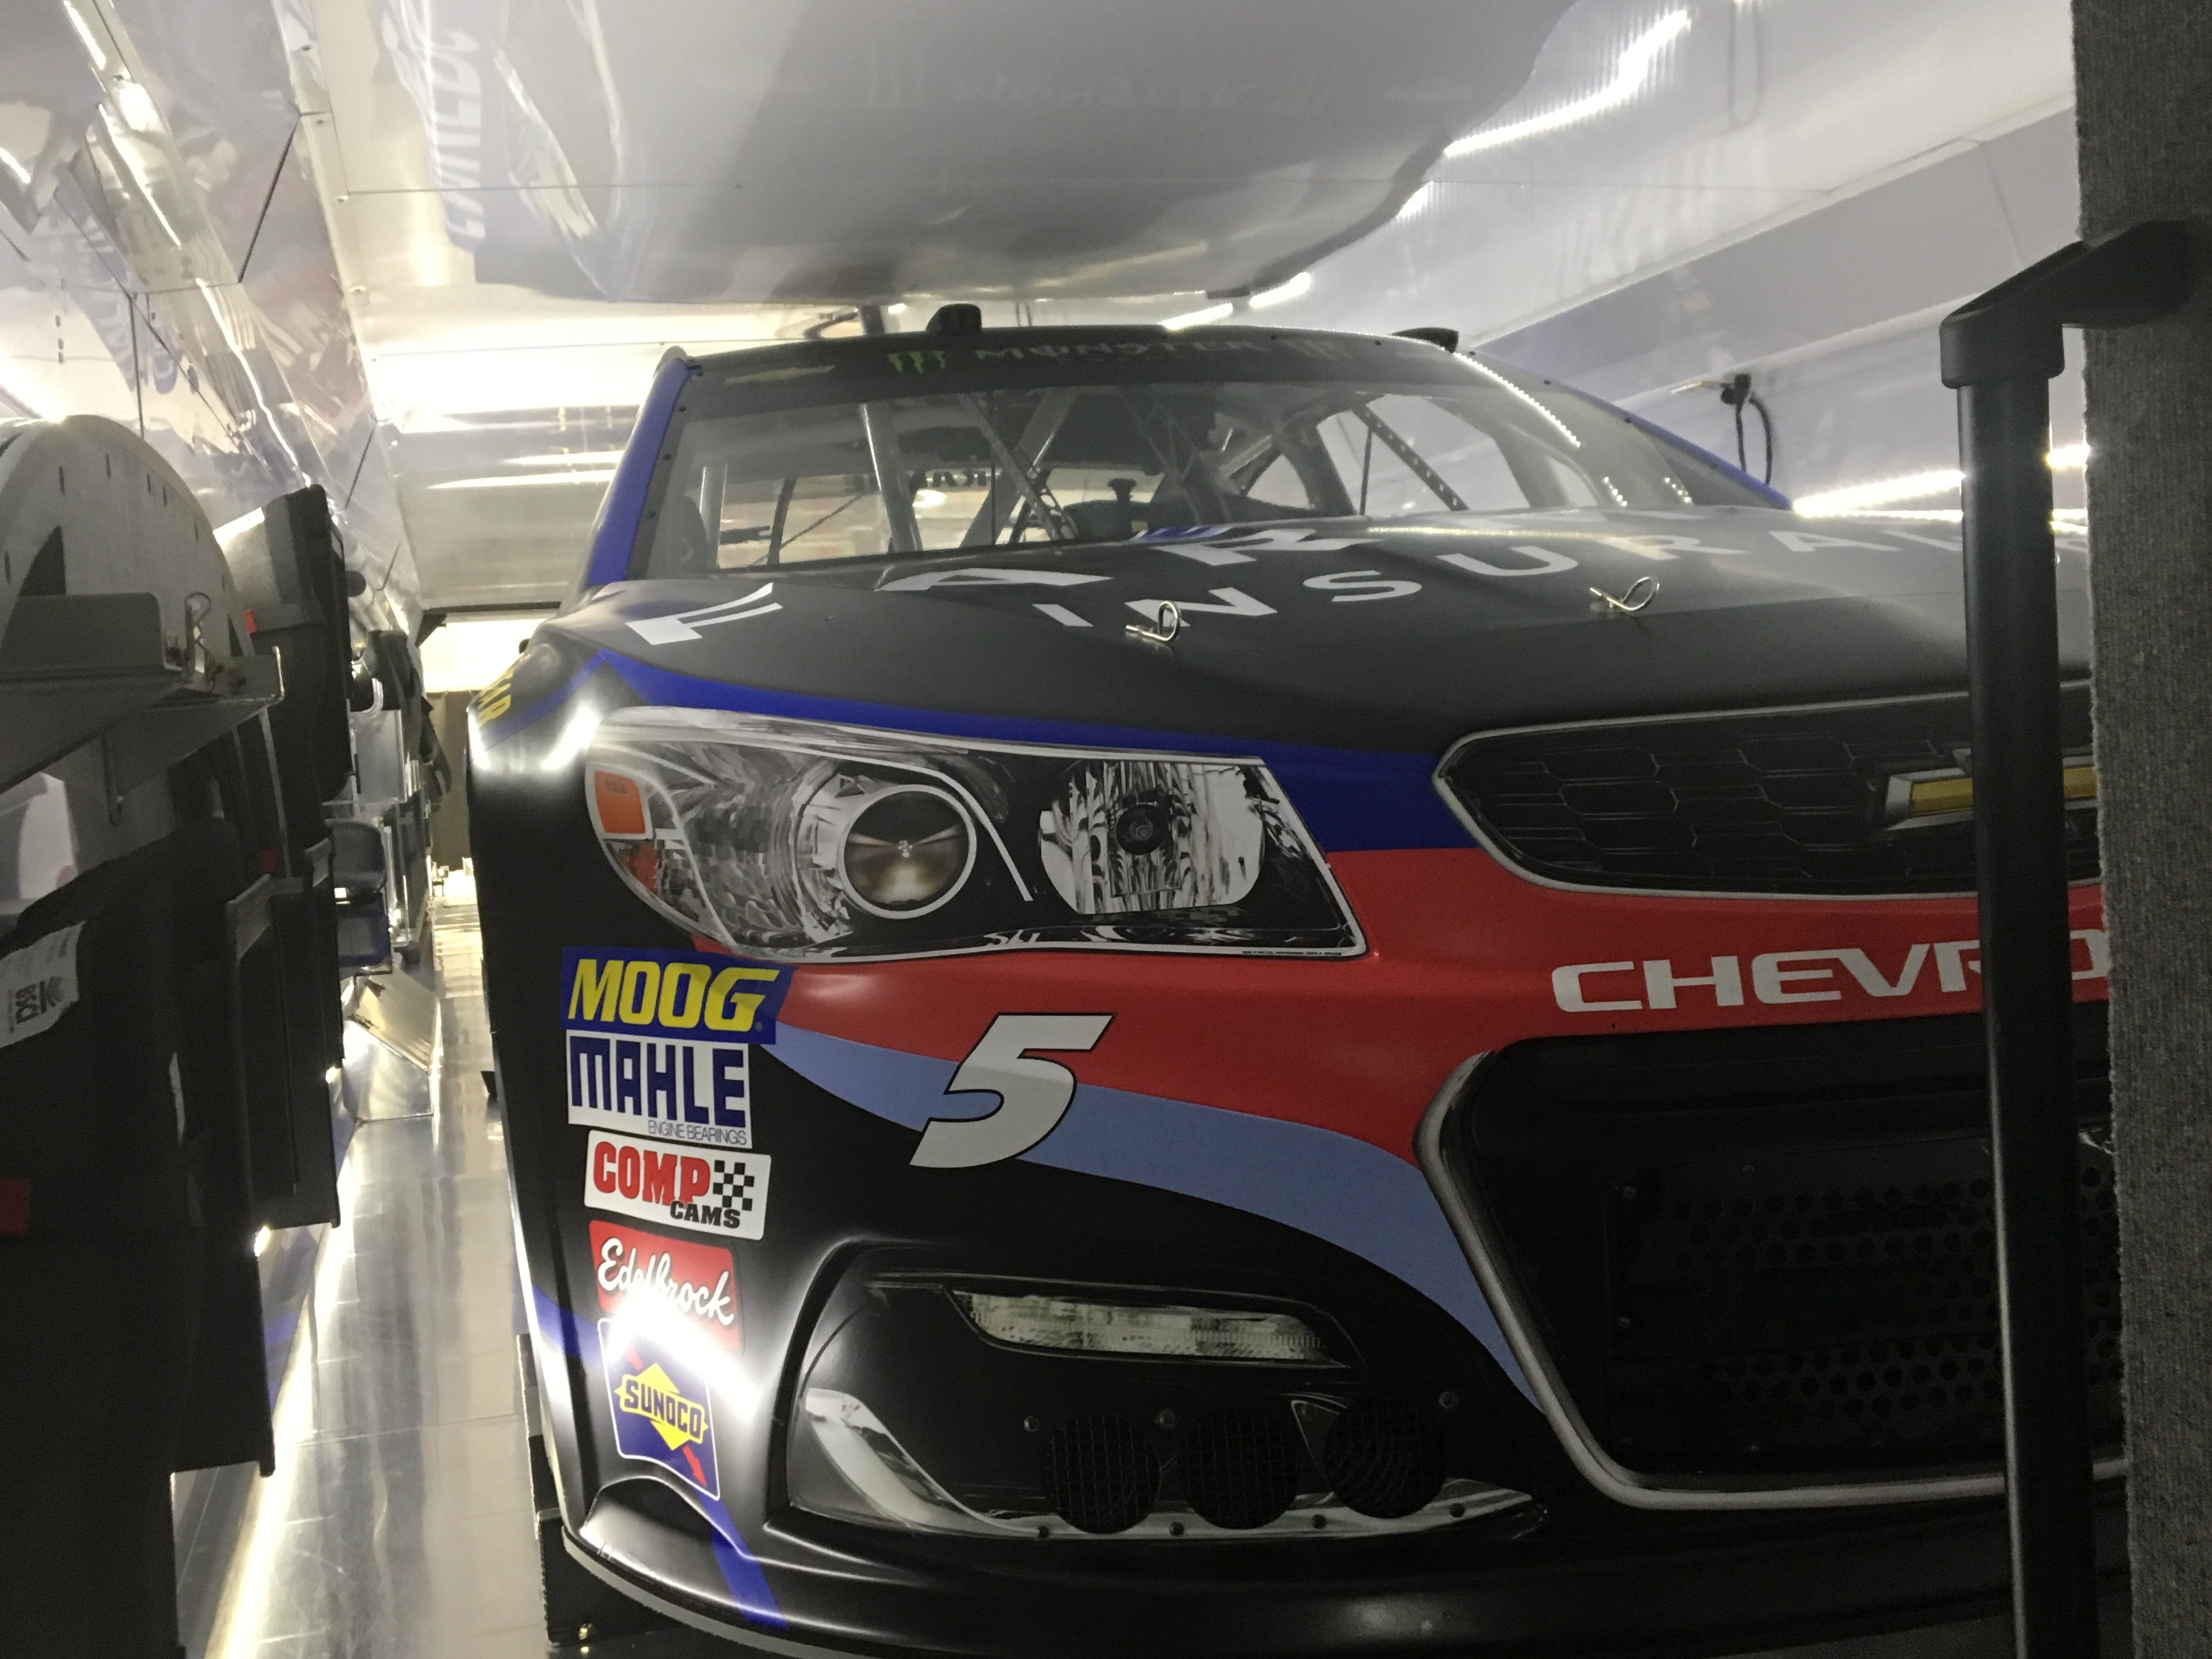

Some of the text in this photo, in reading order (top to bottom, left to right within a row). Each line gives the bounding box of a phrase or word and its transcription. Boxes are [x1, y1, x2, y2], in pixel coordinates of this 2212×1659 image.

[567, 958, 780, 1032] MOOG
[569, 1035, 747, 1128] MAHLE
[909, 1012, 1117, 1169] 5
[648, 1119, 747, 1146] ENGINE BEARINGS
[593, 1141, 711, 1209] COMP
[670, 1200, 741, 1229] CAMS
[597, 1237, 735, 1325] Edelbrock
[624, 1379, 703, 1440] SUNOCO
